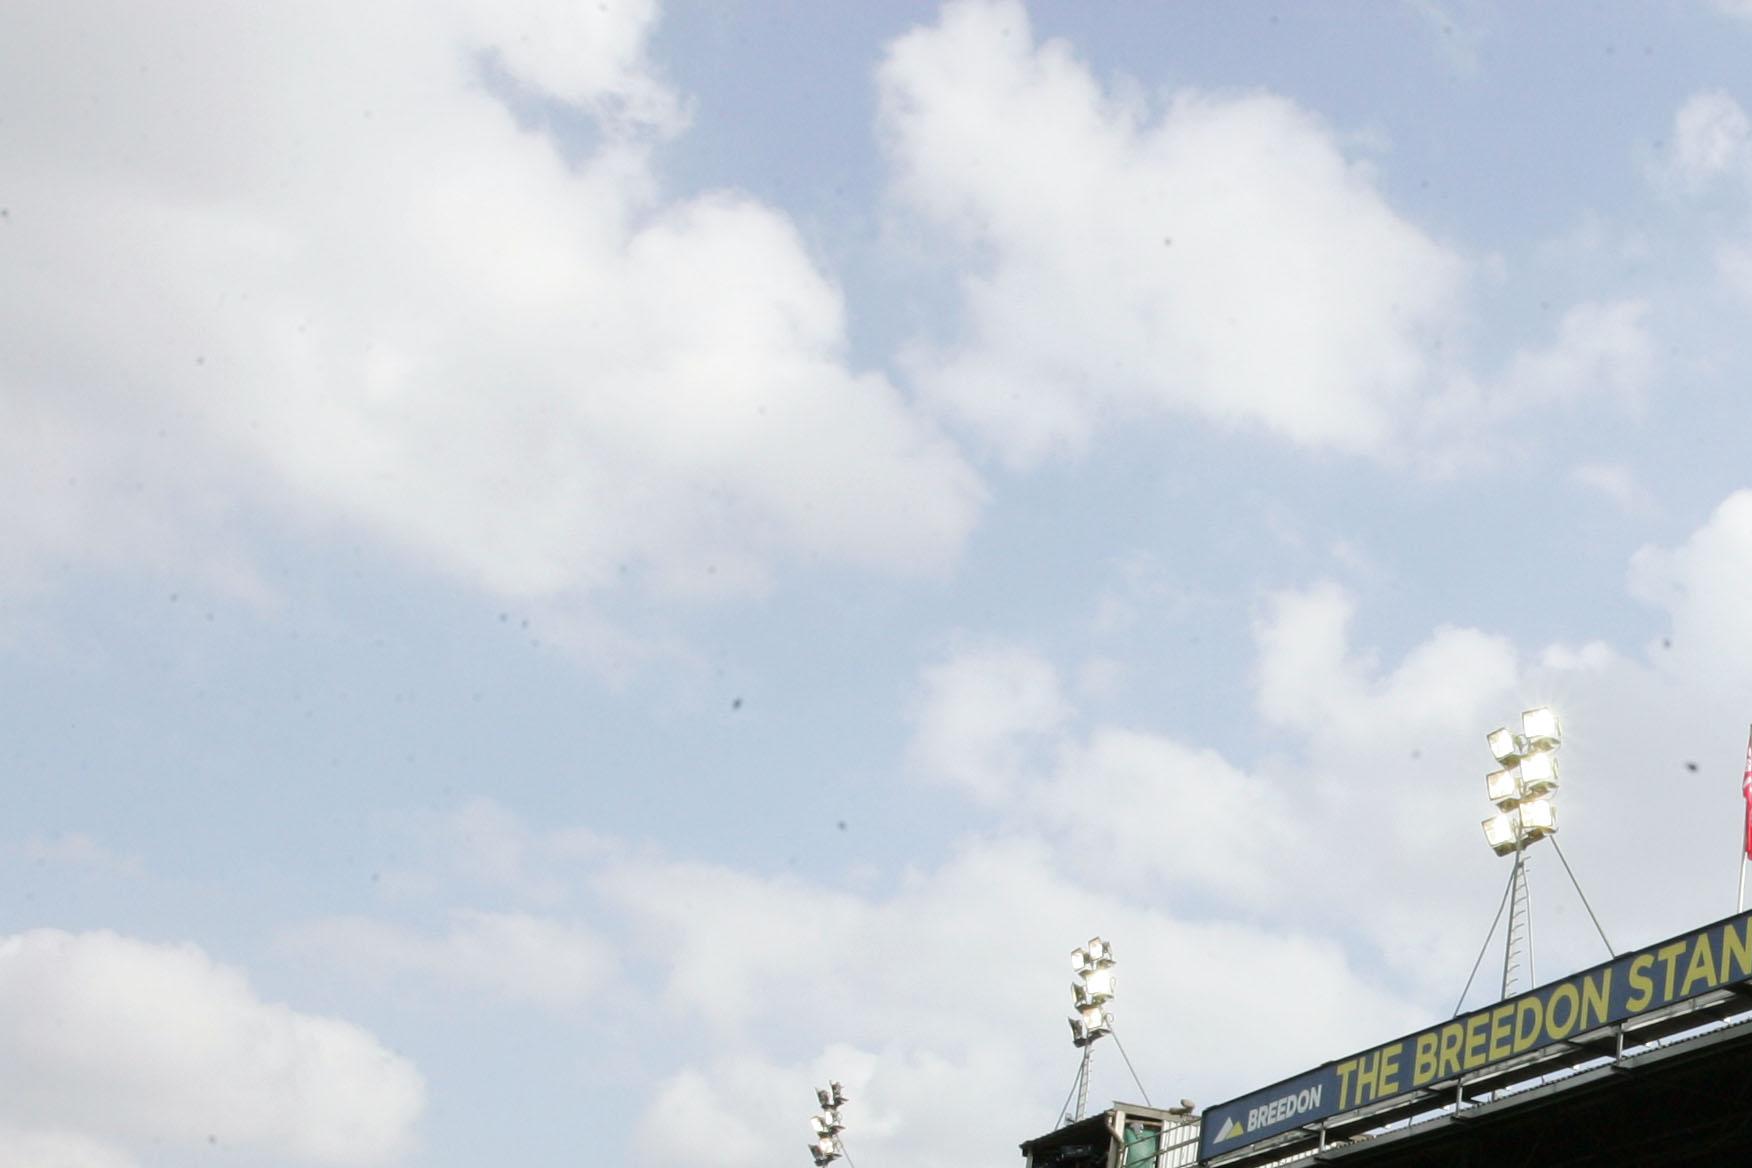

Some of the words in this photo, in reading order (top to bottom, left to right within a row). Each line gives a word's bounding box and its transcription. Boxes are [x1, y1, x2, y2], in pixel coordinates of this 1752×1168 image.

[1336, 1043, 1403, 1111] THE
[1413, 967, 1612, 1087] BREEDON
[1248, 1083, 1322, 1133] BREEDON
